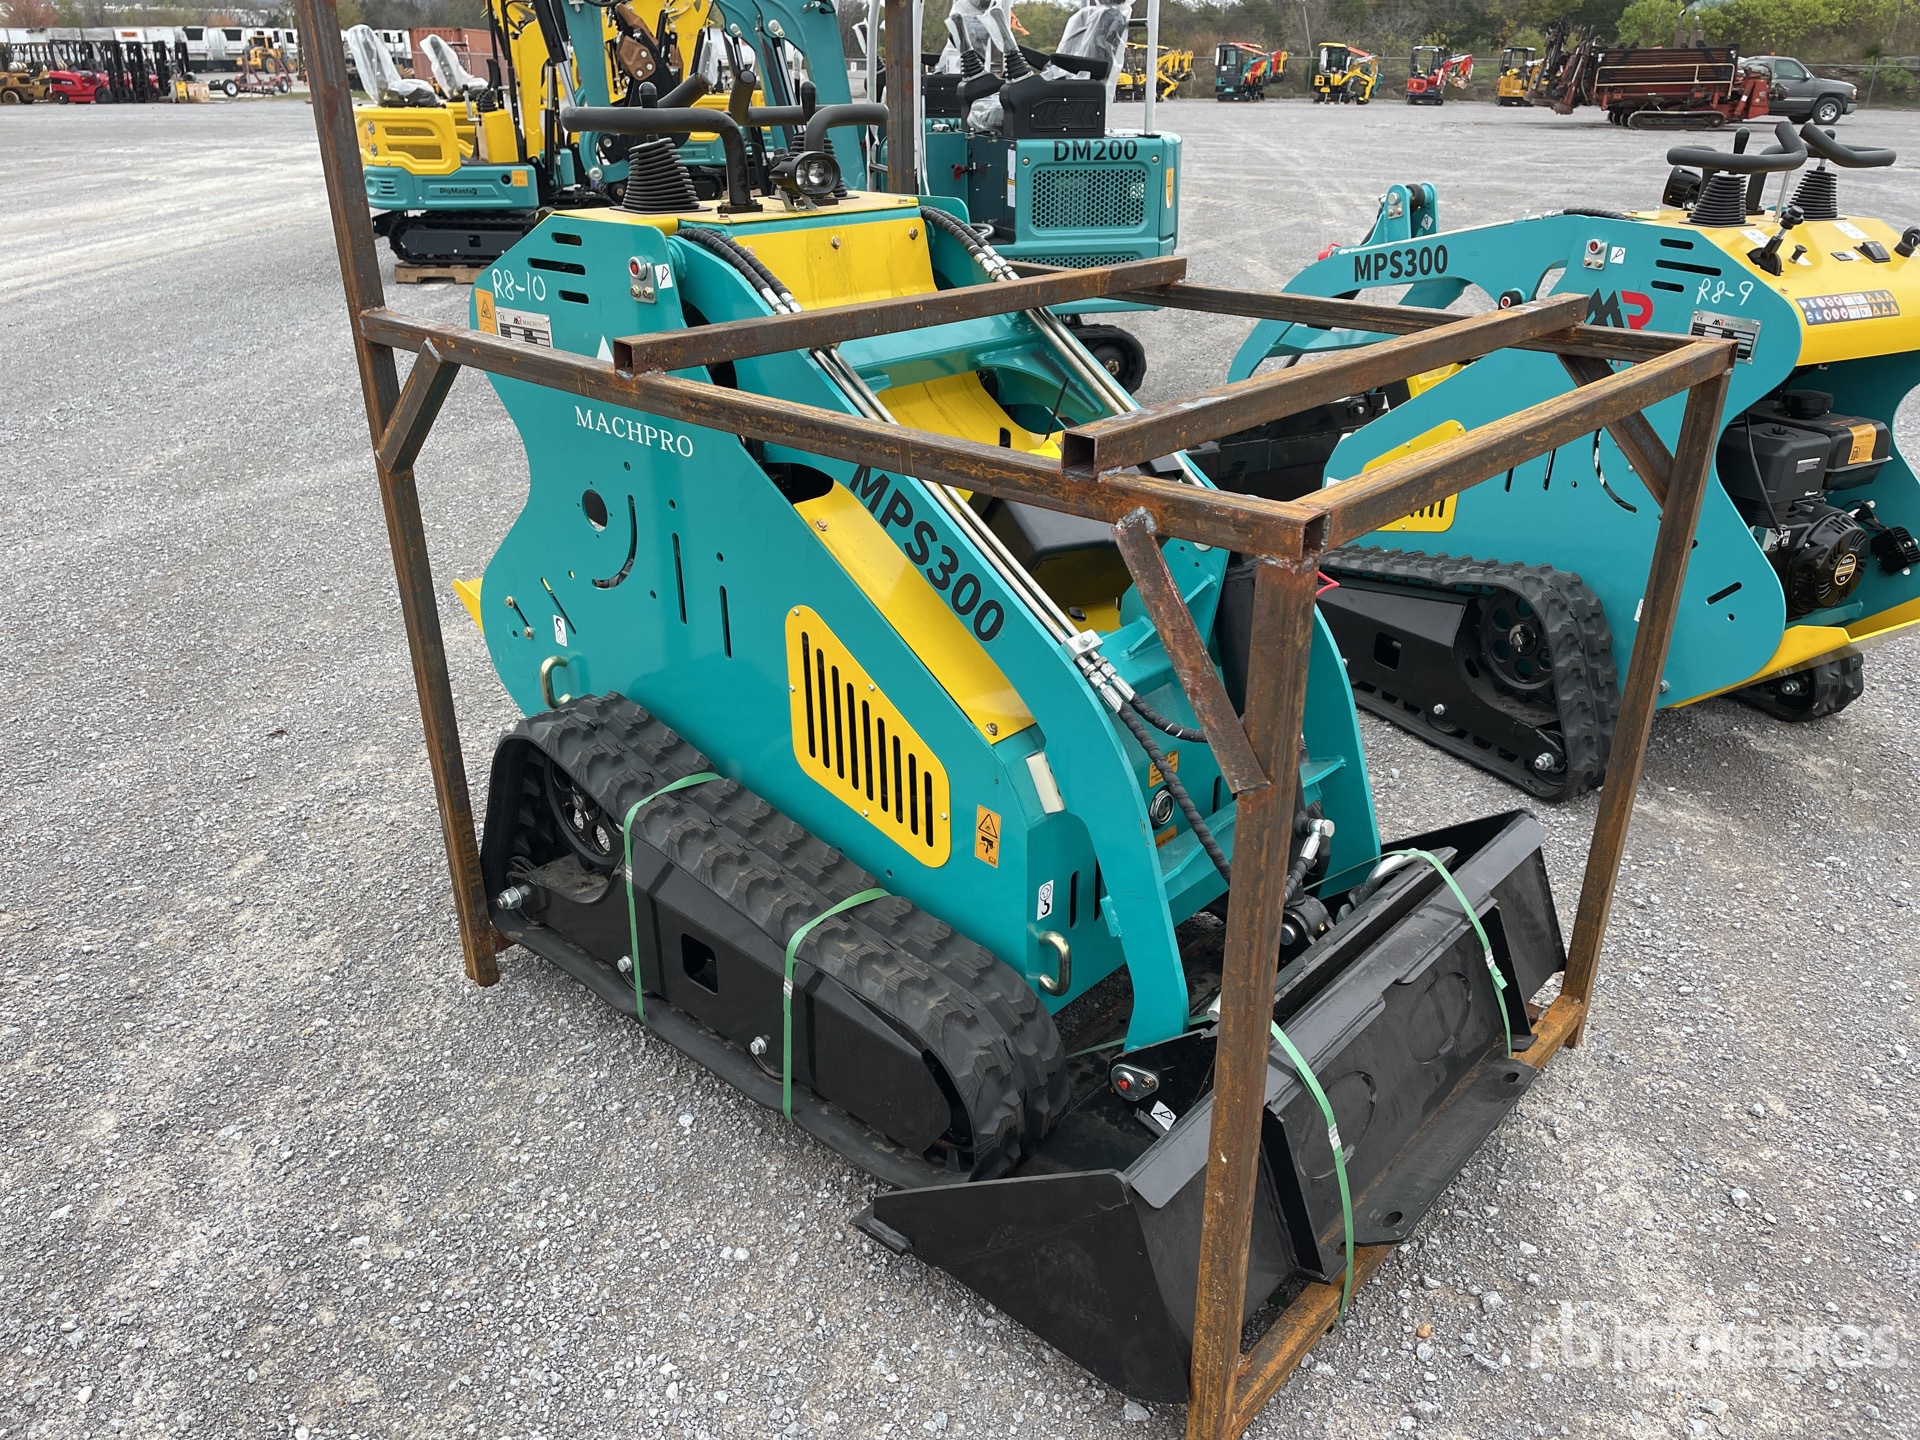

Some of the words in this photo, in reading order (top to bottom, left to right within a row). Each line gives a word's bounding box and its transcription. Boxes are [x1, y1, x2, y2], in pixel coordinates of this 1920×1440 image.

[1053, 139, 1138, 162] DM200
[1354, 245, 1449, 283] MPS300
[492, 268, 546, 302] R8-10
[1696, 278, 1754, 306] R8-9
[574, 405, 694, 458] MACHPRO
[849, 464, 1005, 642] MPS300
